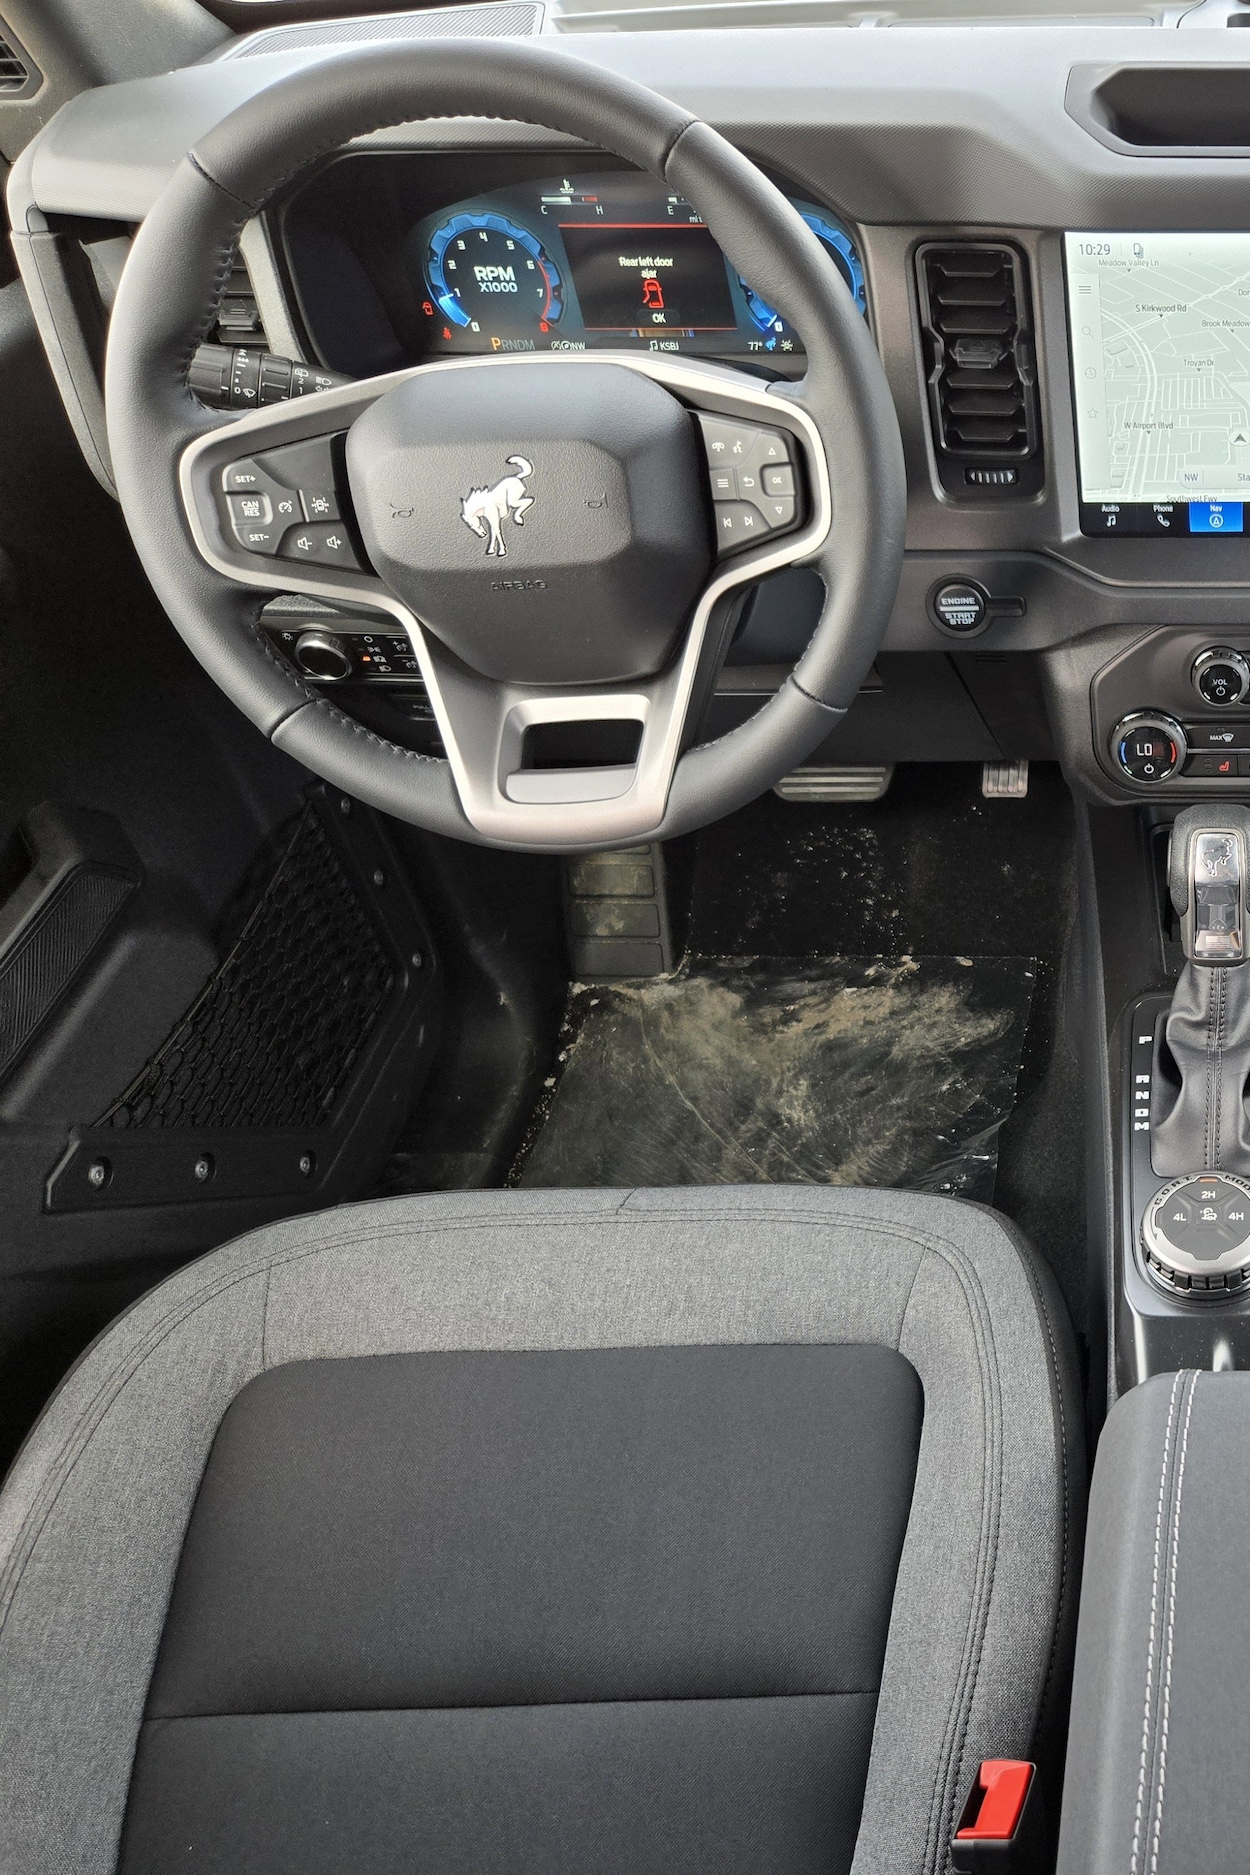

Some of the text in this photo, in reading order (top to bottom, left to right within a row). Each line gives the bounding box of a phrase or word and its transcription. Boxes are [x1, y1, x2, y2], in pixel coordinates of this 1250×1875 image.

[541, 205, 548, 214] C
[596, 206, 603, 215] H
[667, 206, 674, 215] E
[479, 232, 488, 242] 4
[457, 240, 466, 250] 3
[506, 240, 515, 250] 5
[1079, 244, 1110, 256] 10:29
[447, 260, 457, 270] 2
[527, 260, 535, 270] 6
[619, 256, 673, 266] Rear left door
[1098, 259, 1127, 267] Meadow
[1128, 259, 1149, 268] Valley
[473, 266, 516, 281] RPM
[641, 268, 657, 279] ajar
[479, 282, 518, 293] X1000
[454, 288, 461, 297] 1
[537, 288, 543, 297] 7
[1135, 304, 1187, 313] S Kirkwood Rd
[652, 313, 666, 323] OK
[471, 322, 480, 332] 0
[774, 321, 783, 332] 0
[572, 342, 585, 350] NW
[660, 342, 679, 350] KSBJ
[1183, 359, 1205, 368] Troyan
[1124, 422, 1174, 431] W Airport Blvd
[235, 475, 256, 483] SET+
[1184, 473, 1198, 481] NW
[241, 500, 259, 508] CAN
[1102, 504, 1120, 513] Audio
[1153, 504, 1174, 513] Phone
[1210, 504, 1223, 512] Nav
[244, 509, 260, 517] RES
[941, 597, 976, 605] ENGINE
[945, 611, 977, 620] START
[1136, 743, 1153, 756] LO
[1139, 1036, 1153, 1044] P
[1135, 1091, 1150, 1100] N
[1134, 1122, 1150, 1131] M
[1201, 1191, 1216, 1199] 2H
[1173, 1213, 1187, 1222] 4L
[1228, 1212, 1244, 1221] 4H
